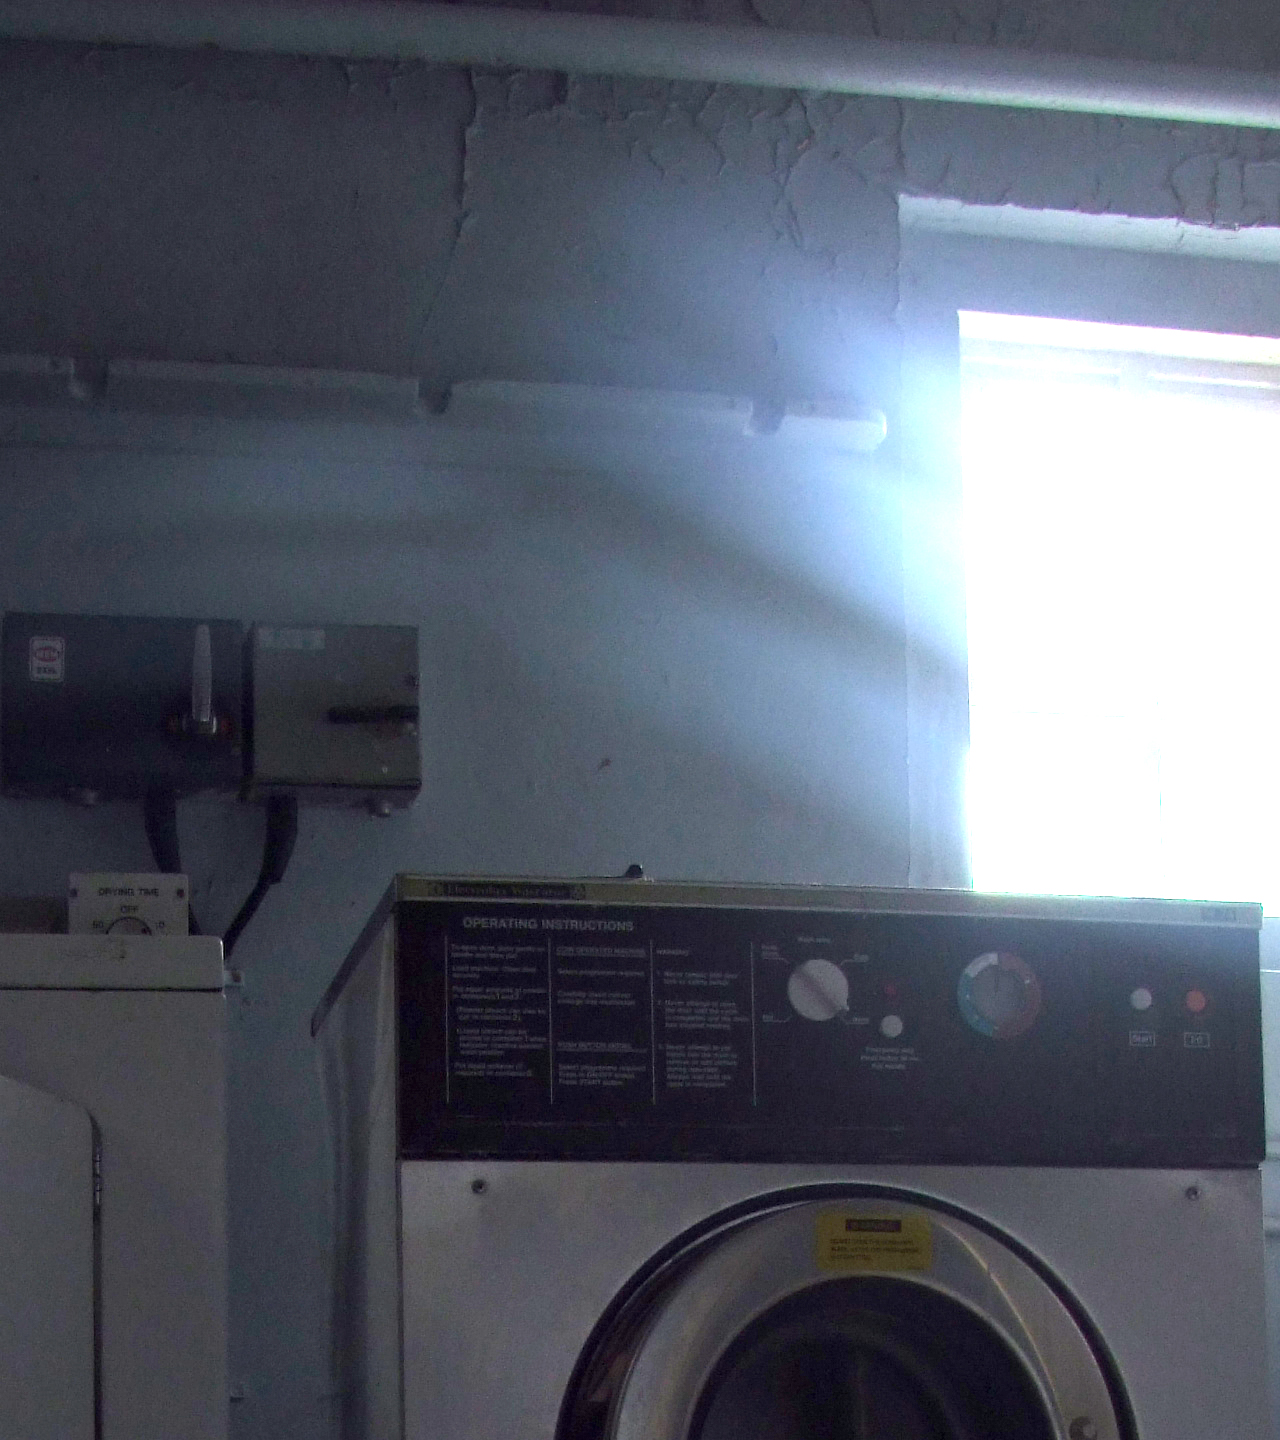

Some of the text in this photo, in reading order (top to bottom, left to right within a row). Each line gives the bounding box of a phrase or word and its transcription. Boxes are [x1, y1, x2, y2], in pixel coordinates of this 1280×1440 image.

[98, 887, 159, 897] DRYING TIME
[120, 905, 139, 913] OFF
[462, 916, 634, 931] OPERATING INSTRUCTIONS
